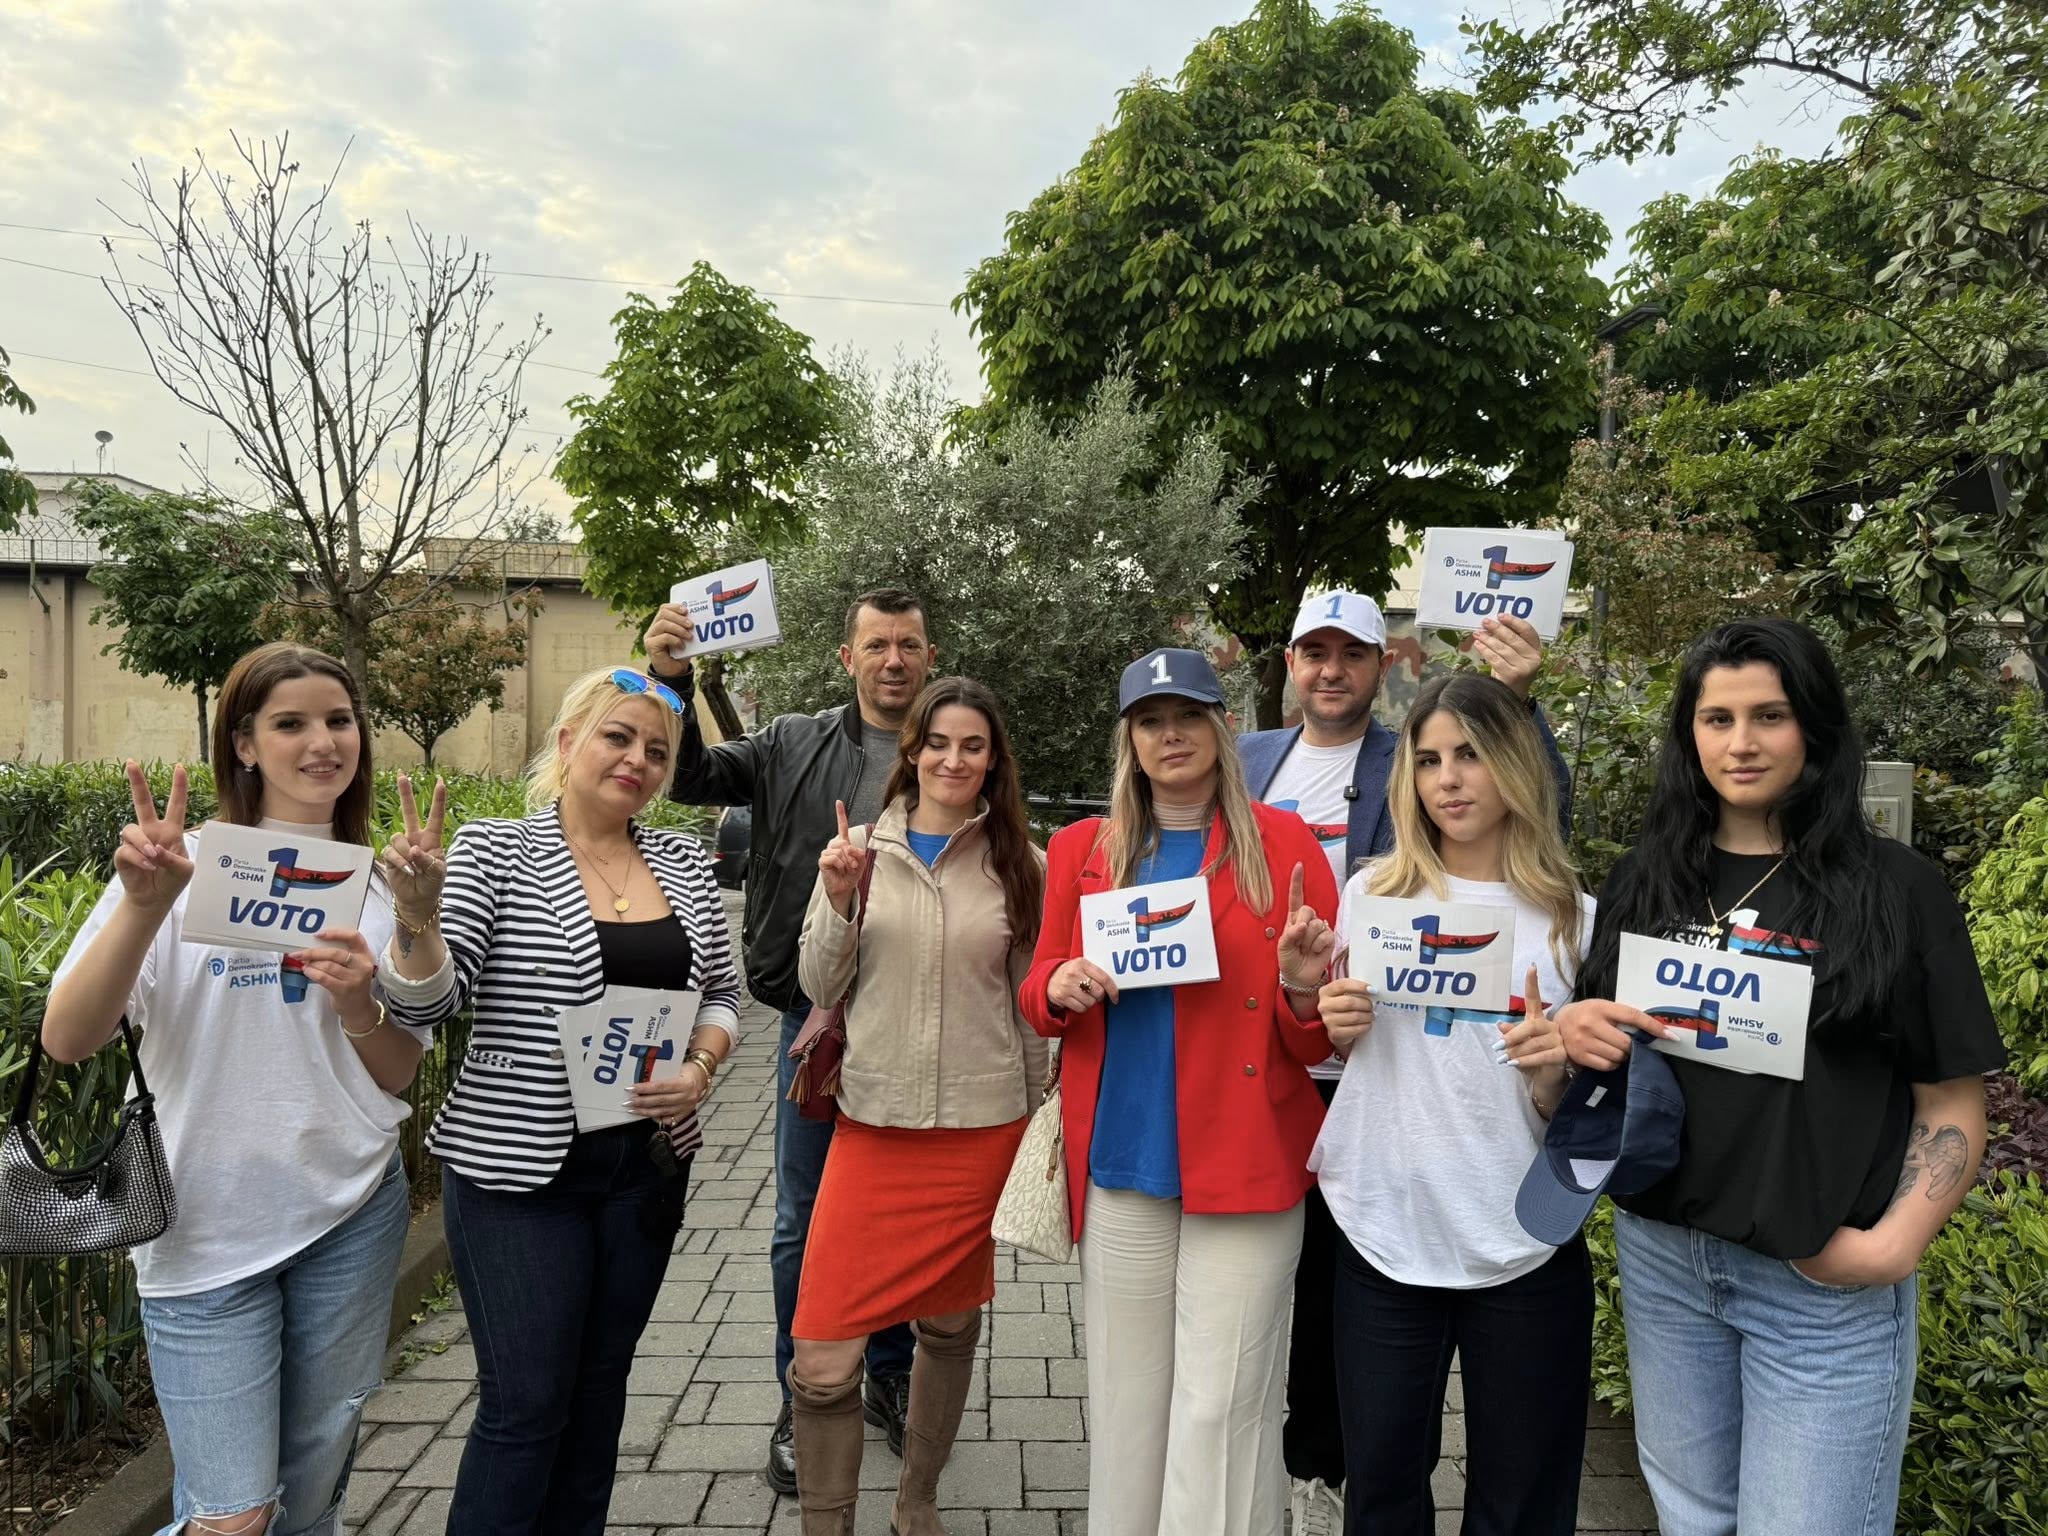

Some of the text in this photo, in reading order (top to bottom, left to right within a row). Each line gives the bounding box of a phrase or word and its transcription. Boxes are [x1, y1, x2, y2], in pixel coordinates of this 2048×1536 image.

[1455, 569, 1481, 578] ASHM
[690, 604, 708, 614] ASHM
[1323, 595, 1343, 619] 1
[1455, 590, 1533, 619] VOTO
[695, 613, 754, 643] VOTO
[1149, 654, 1172, 685] 1
[231, 871, 264, 883] ASHM
[229, 896, 326, 934] VOTO
[1107, 927, 1130, 937] ASHM
[1382, 941, 1412, 952] ASHM
[228, 957, 250, 965] Partia
[228, 962, 278, 972] Demokratike
[1111, 943, 1187, 975] VOTO
[229, 972, 278, 989] ASHM
[1385, 966, 1477, 996] VOTO
[1656, 958, 1760, 1002] VOTO
[644, 1016, 657, 1039] ASHM
[1728, 1015, 1764, 1029] ASHM
[593, 1017, 634, 1085] VOTO
